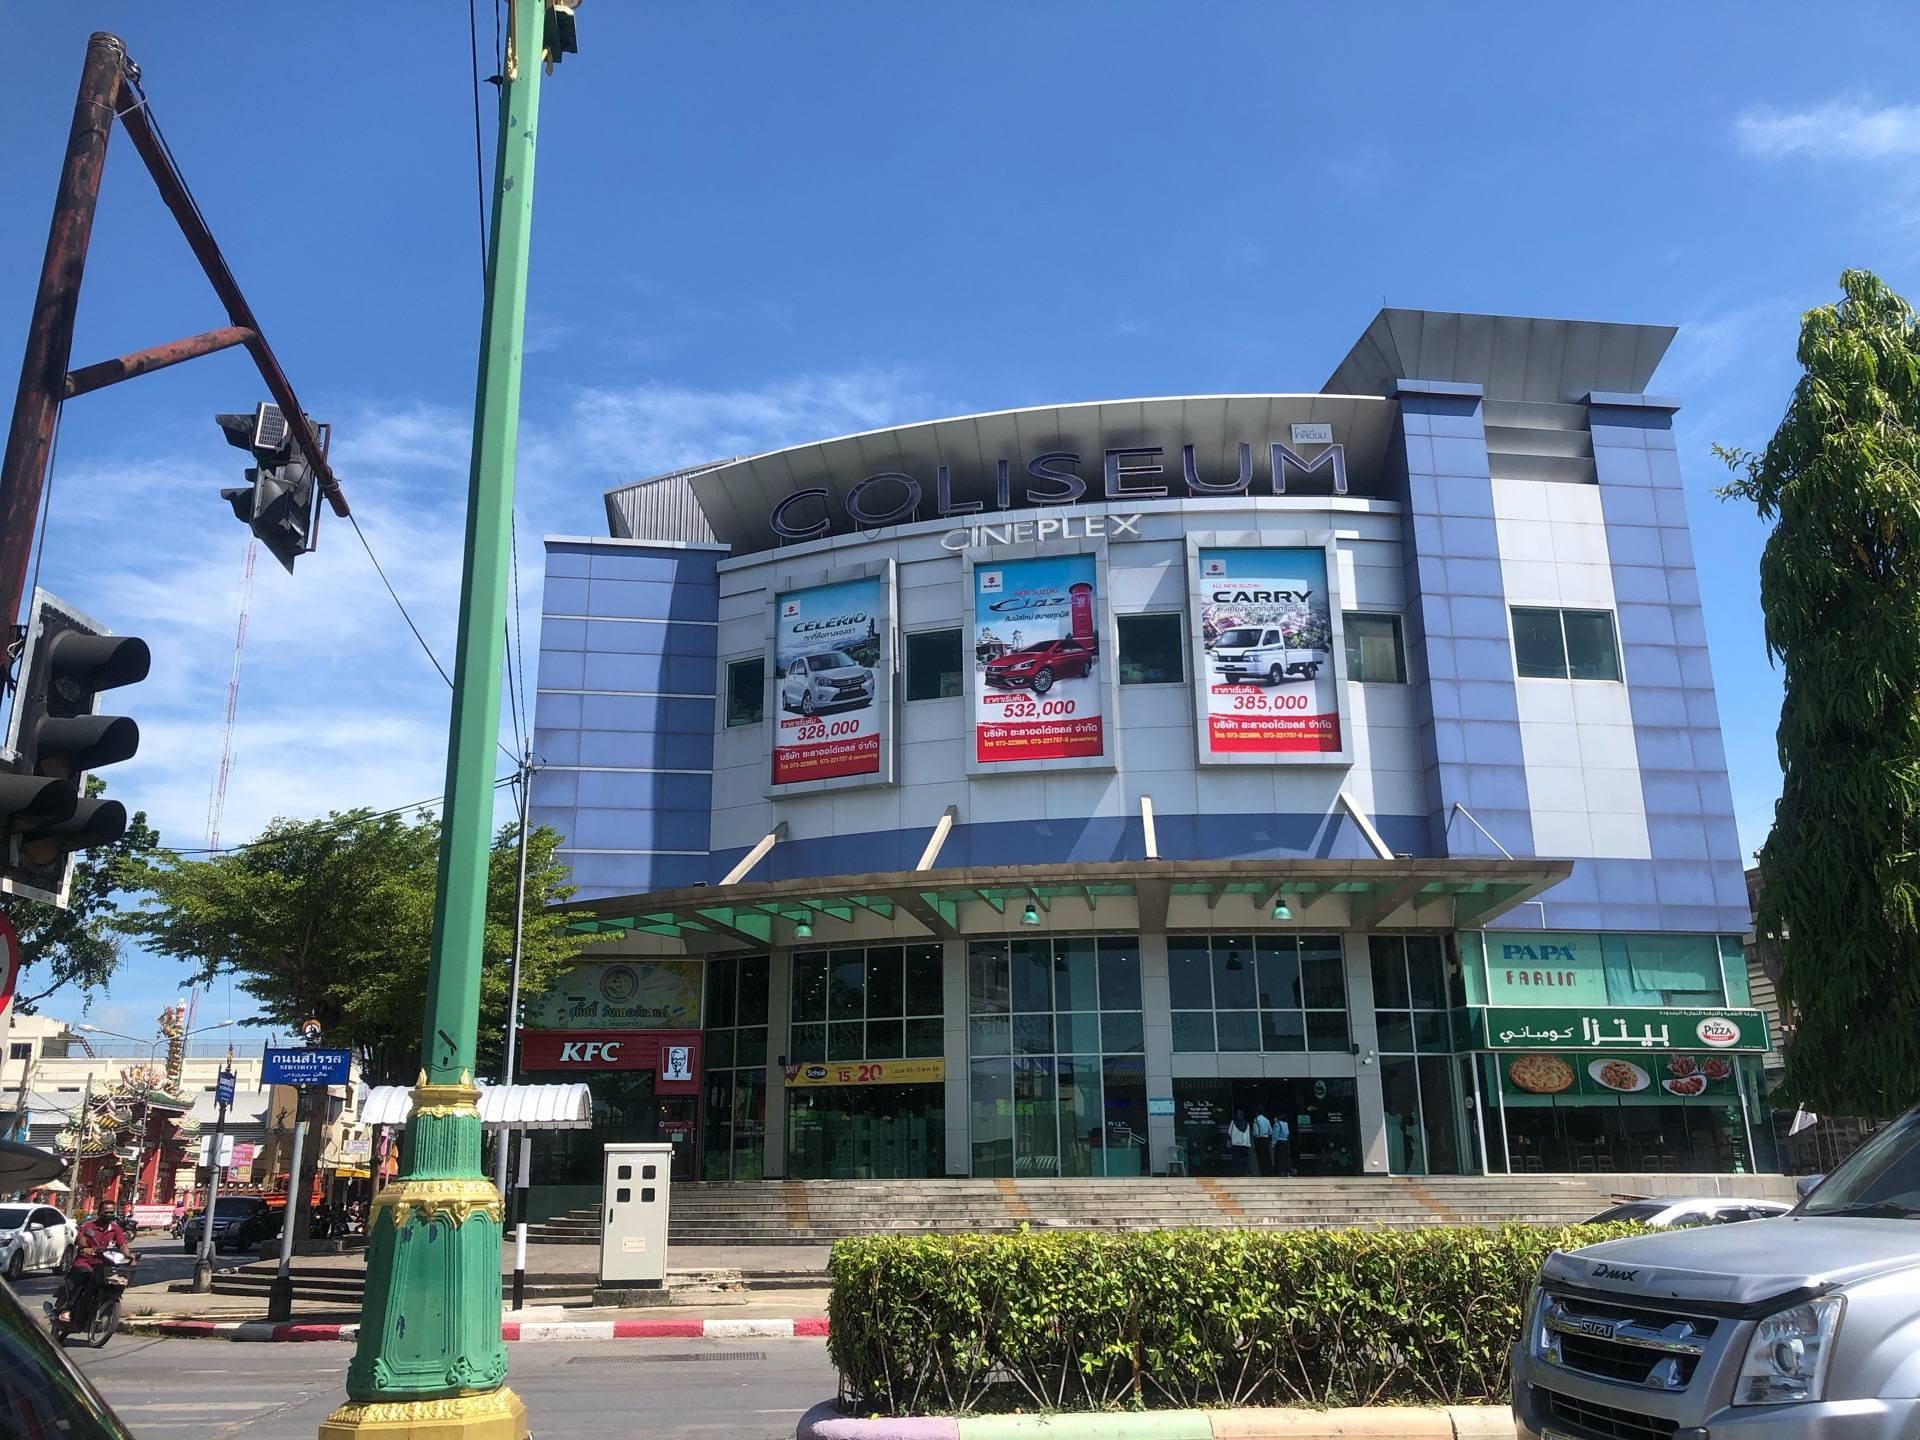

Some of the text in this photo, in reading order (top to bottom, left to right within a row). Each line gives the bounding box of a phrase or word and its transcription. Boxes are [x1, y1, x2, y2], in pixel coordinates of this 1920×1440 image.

[770, 443, 1348, 538] COLISEUM
[941, 514, 1143, 550] CINEPLEX
[1213, 591, 1313, 603] CARRY
[793, 611, 867, 633] CELERIO
[1003, 700, 1076, 719] 532,000
[1233, 695, 1308, 712] 385,000
[797, 719, 860, 741] 328,000
[1502, 944, 1576, 961] PAPA
[1582, 1017, 1669, 1046] بيتزا
[1704, 1025, 1732, 1036] PIZZA
[560, 1042, 620, 1062] KFC
[1580, 1321, 1613, 1338] ISUZU
